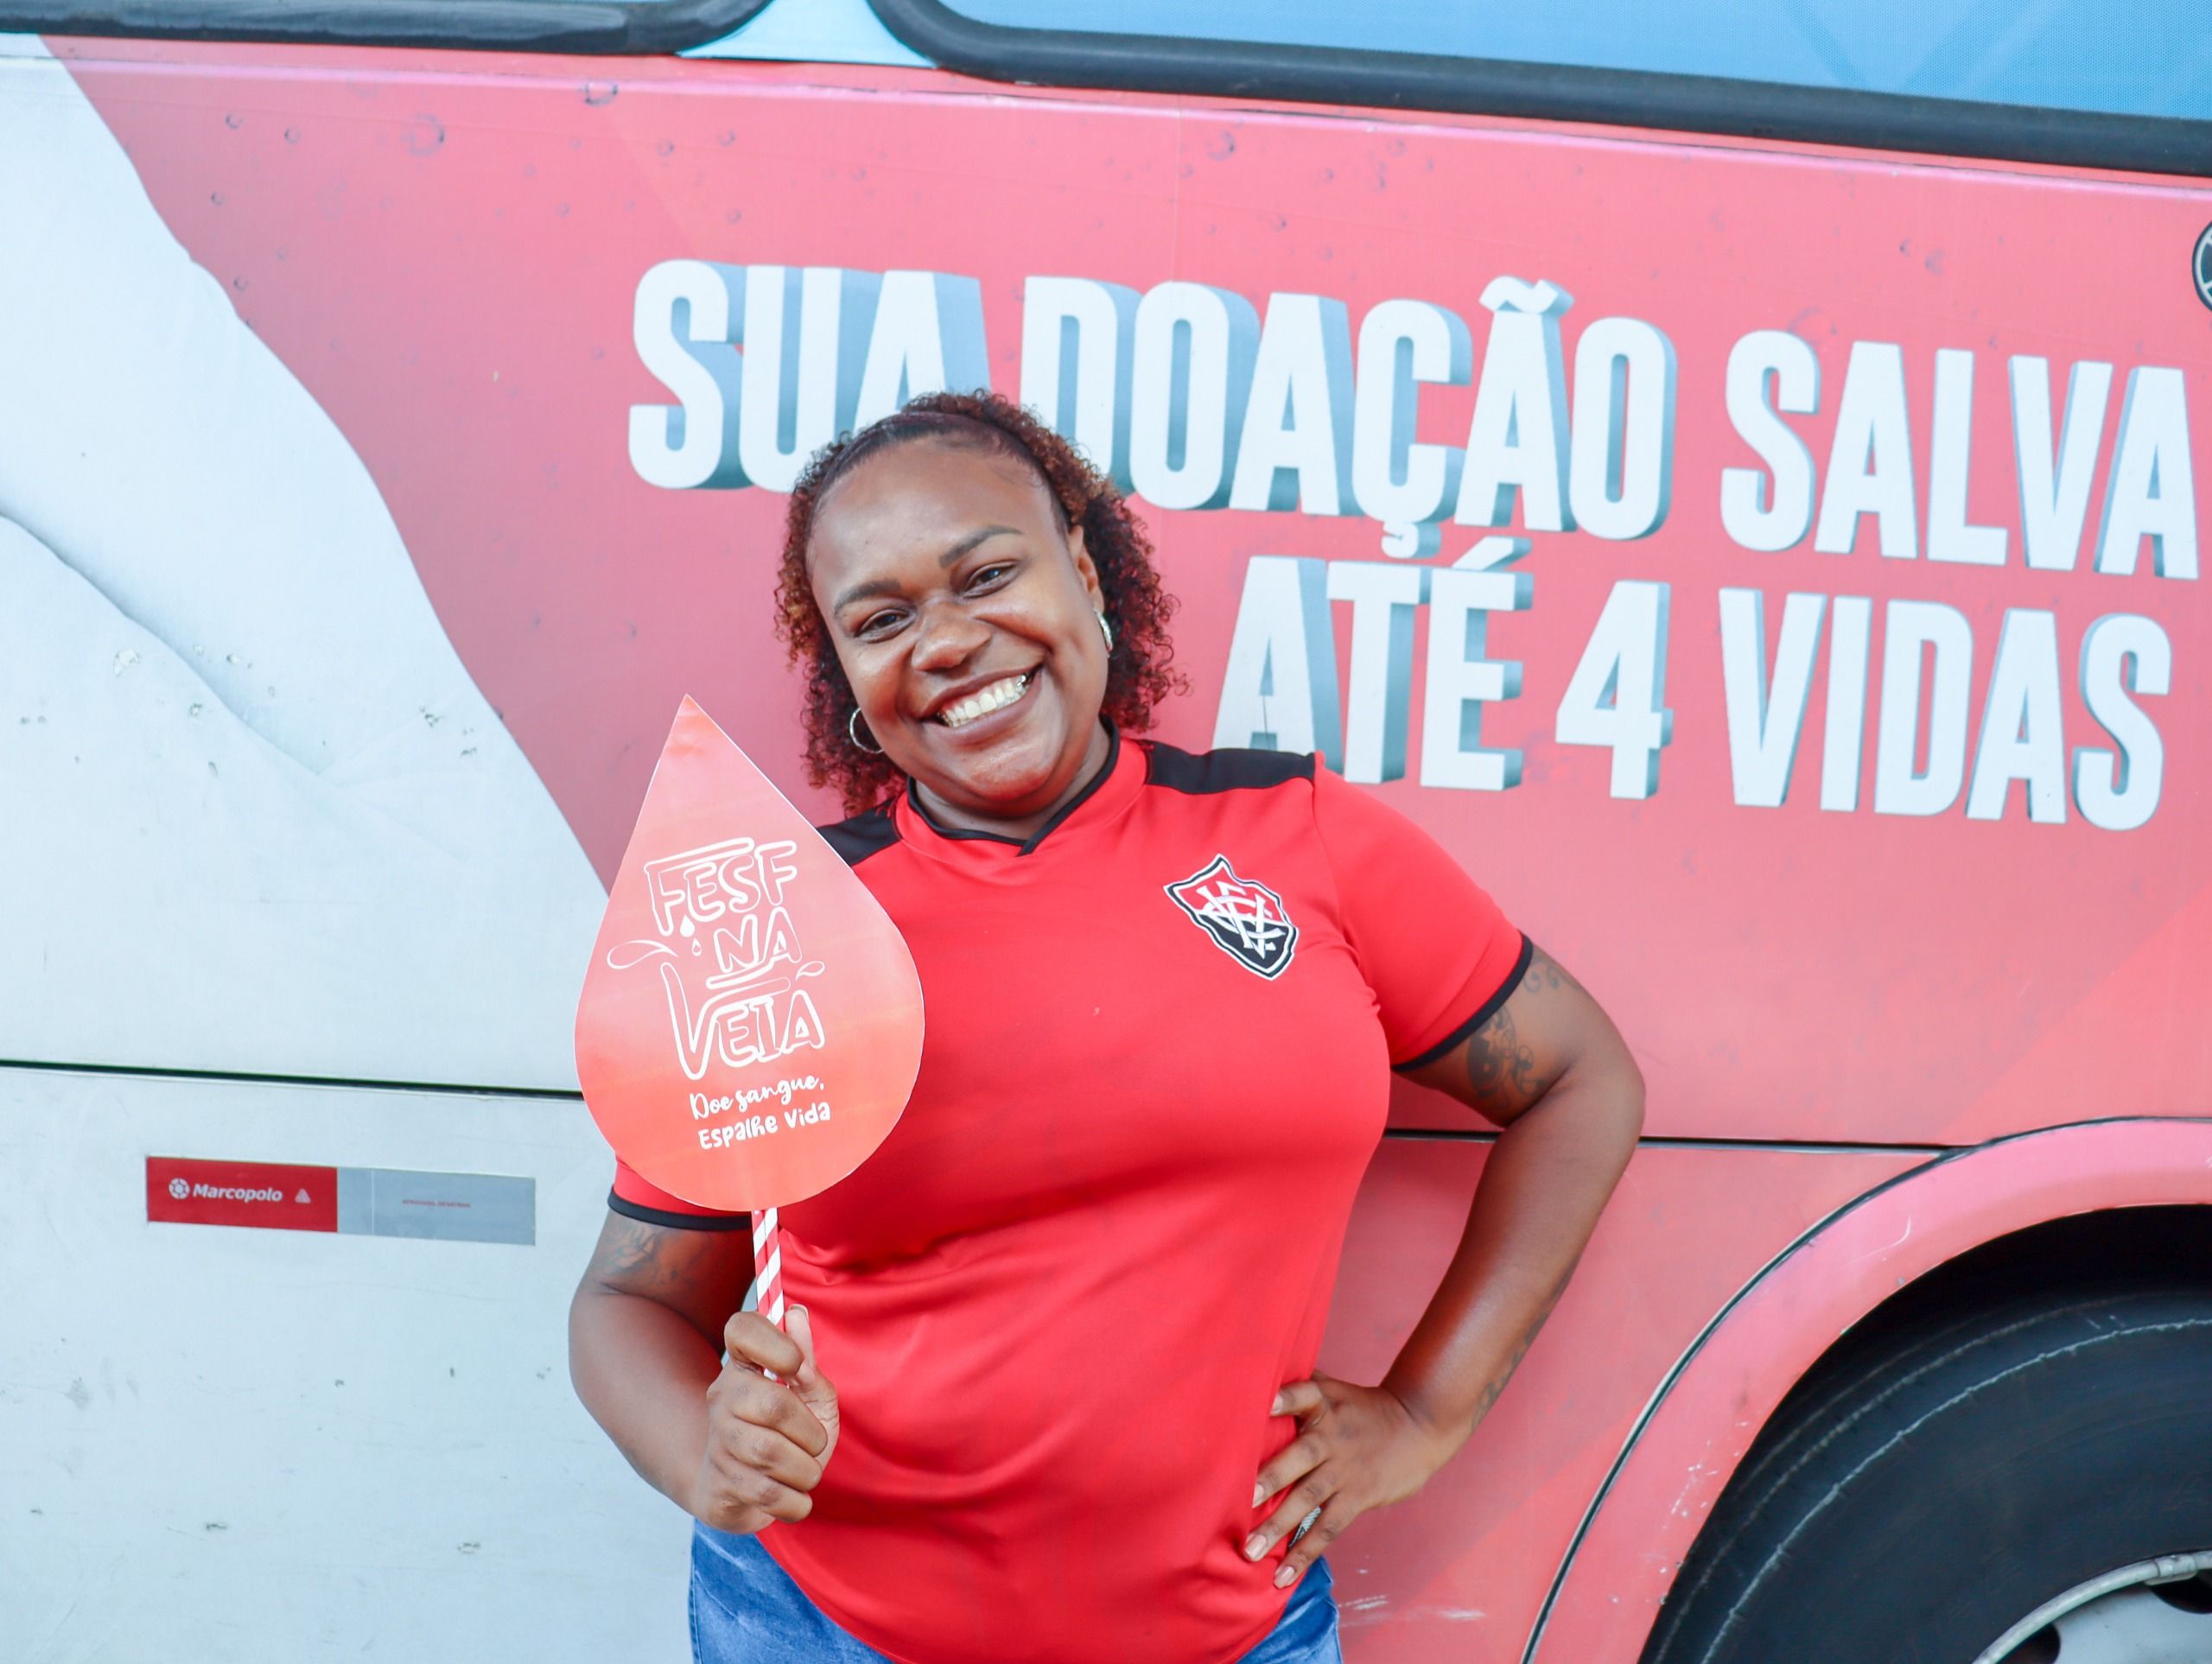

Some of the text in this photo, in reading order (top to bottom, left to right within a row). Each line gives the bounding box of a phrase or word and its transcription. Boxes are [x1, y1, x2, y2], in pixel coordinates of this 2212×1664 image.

[627, 259, 2199, 580] SUA DOAÇÃO SALVA
[1211, 537, 2171, 831] ATÉ 4 VIDAS
[644, 836, 798, 937] FESF
[706, 906, 802, 990] NA
[660, 962, 825, 1081] VEIA
[689, 1092, 734, 1120] Doe
[697, 1102, 831, 1150] Espalhe Vida
[192, 1183, 283, 1204] Marcopolo
